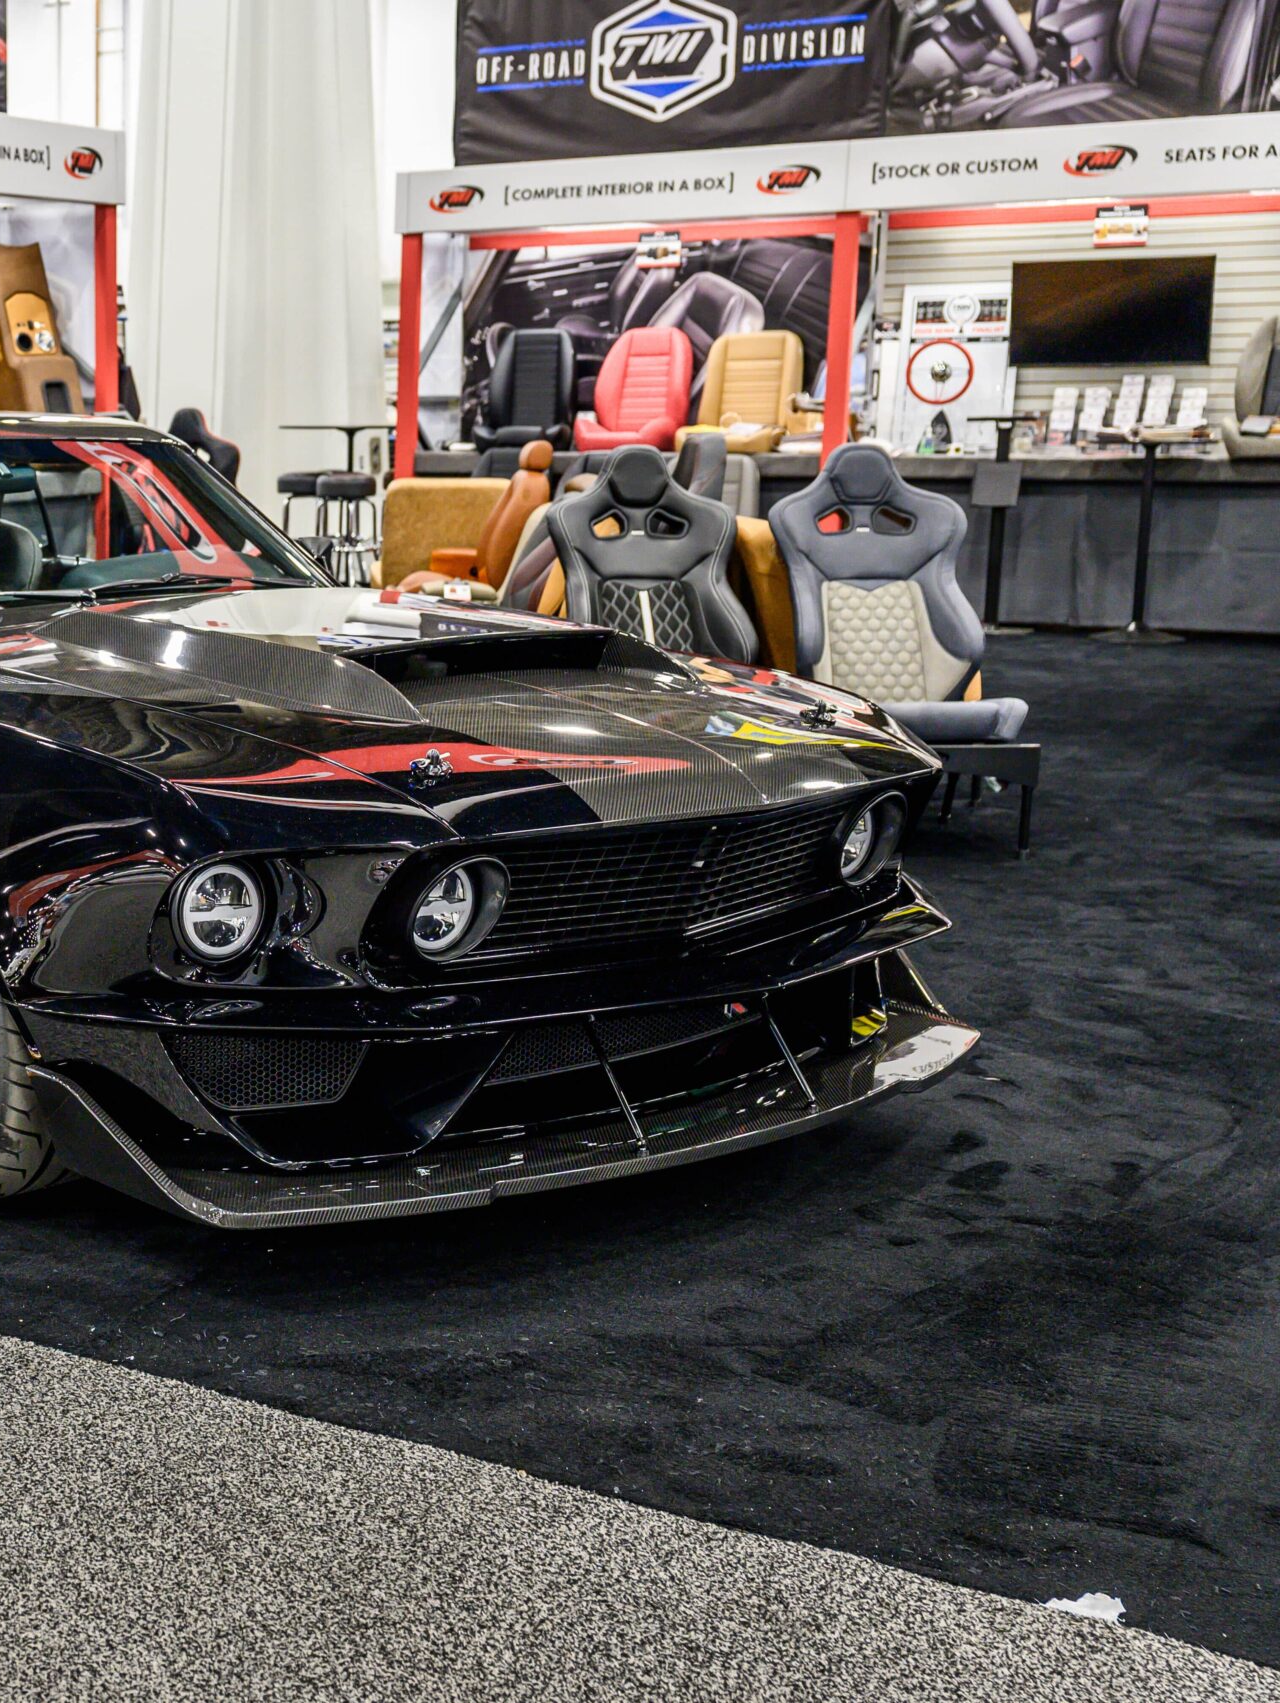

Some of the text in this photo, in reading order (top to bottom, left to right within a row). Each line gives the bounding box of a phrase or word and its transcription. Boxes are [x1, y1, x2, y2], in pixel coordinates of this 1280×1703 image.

[476, 25, 865, 84] OFF-ROAD TMI DIVISION
[0, 145, 12, 161] IN
[13, 147, 22, 162] A
[1076, 149, 1126, 171] TMI
[1164, 146, 1216, 164] SEATS
[1222, 145, 1259, 160] FOR
[936, 160, 961, 175] OR
[965, 157, 1039, 174] CUSTOM
[586, 181, 654, 197] INTERIOR
[658, 180, 675, 193] IN
[678, 179, 690, 192] A
[767, 168, 813, 190] TMI
